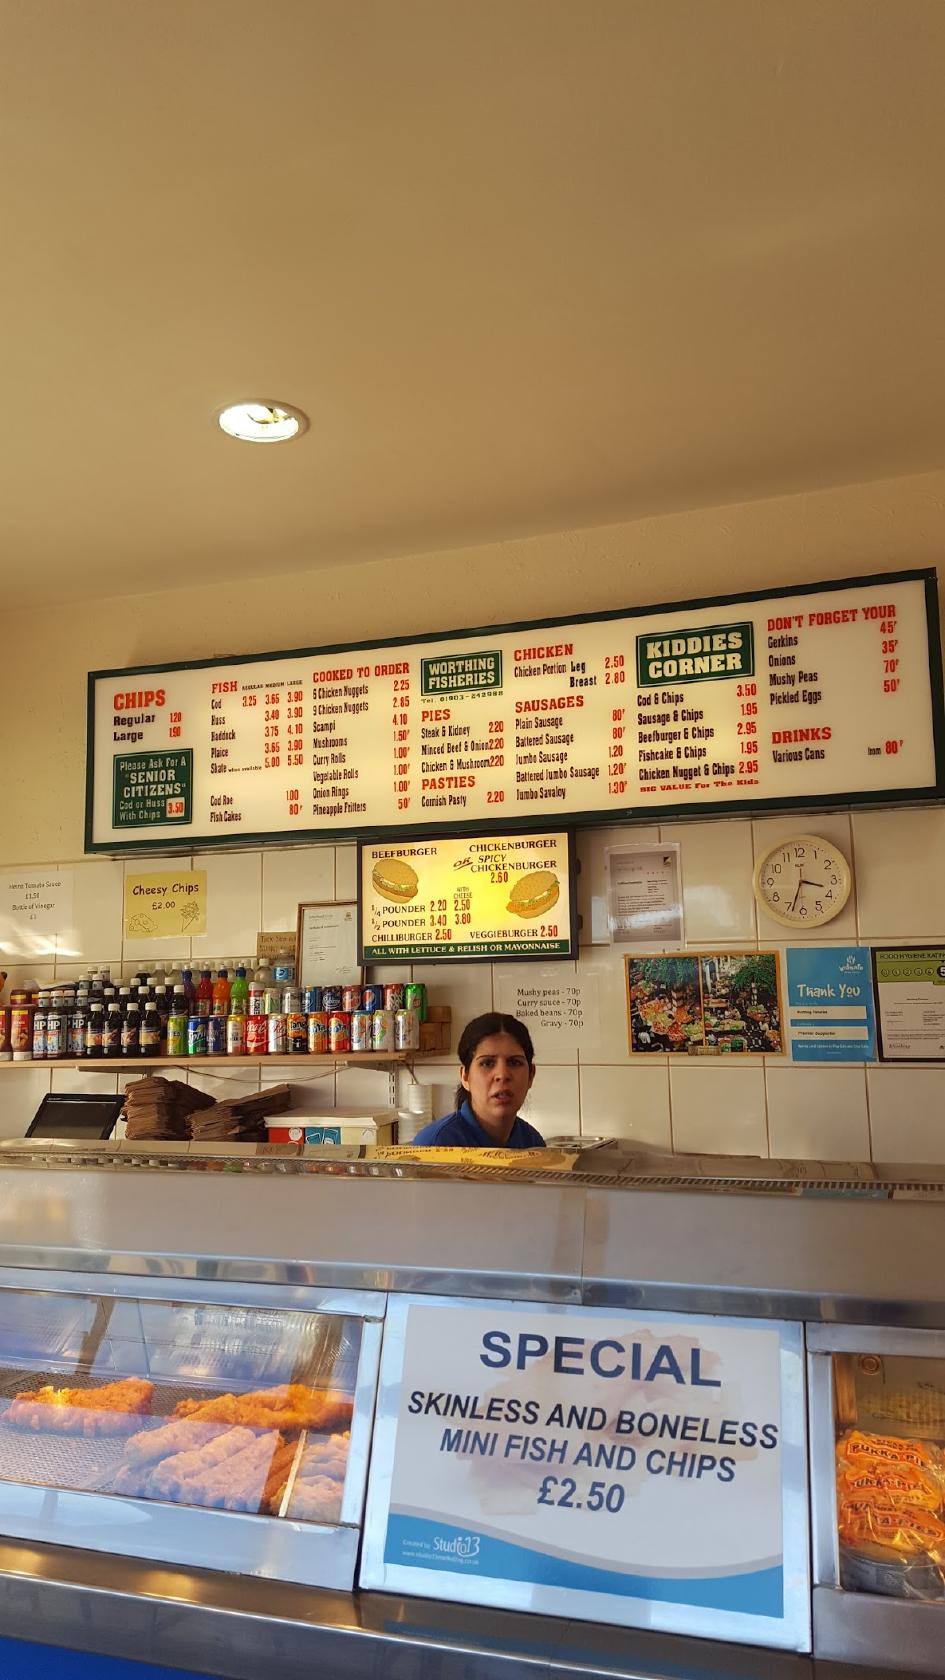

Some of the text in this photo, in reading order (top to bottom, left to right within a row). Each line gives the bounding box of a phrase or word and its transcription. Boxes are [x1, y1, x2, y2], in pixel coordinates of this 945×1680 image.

[768, 604, 896, 632] DON'T FORGET YOUR
[646, 632, 742, 658] KIDDIES
[768, 635, 798, 648] Gerkins
[514, 644, 573, 662] CHICKEN
[428, 657, 495, 676] WORTHING
[514, 655, 624, 678] Chicken Leg 2.50
[648, 653, 742, 679] CORNER
[768, 654, 796, 667] Onions
[313, 662, 410, 683] COOKED TO ORDER
[570, 671, 625, 688] Breast 2.80
[770, 671, 818, 686] Mushy Peas
[428, 671, 495, 689] FISHERIES
[212, 681, 238, 694] FISH
[318, 680, 410, 700] Chicken Nuggets 2.25
[114, 689, 166, 711] CHIPS
[638, 684, 756, 706] Cod Chips 3.50
[770, 690, 822, 706] Pickled Eggs
[318, 701, 368, 716] Chicken Nuggets
[515, 695, 584, 713] SAUSAGES
[114, 714, 156, 727] Regular
[421, 708, 450, 722] PIES
[638, 709, 704, 726] Sausage Chips
[313, 720, 336, 733] Scampi
[516, 716, 563, 730] Plain Sausage
[114, 731, 144, 742] Large
[211, 730, 236, 741] Haddock
[422, 725, 470, 739] Steak Kidney
[638, 722, 756, 744] Beefburger Chips 2.95
[772, 727, 832, 744] DRINKS
[313, 737, 348, 749] Mushrooms
[516, 732, 574, 748] Battered Sausage
[211, 746, 228, 758] Plaice
[422, 741, 462, 756] Minced Beef
[516, 745, 623, 765] Jumbo Sausage 1.20
[638, 746, 706, 762] Fishcake Chips
[772, 746, 882, 763] Various Cans from
[120, 758, 178, 772] Please Ask For
[313, 752, 346, 766] Curry Rolls
[210, 763, 227, 774] Skate
[422, 760, 448, 773] Chicken
[638, 760, 758, 781] Chicken Nugget Chips 2.95
[313, 768, 358, 784] Vegetable Rolls
[516, 766, 600, 782] Battered Jumbo Sausage
[422, 776, 476, 790] PASTIES
[313, 786, 349, 799] Onion Rings
[422, 790, 504, 807] Cornish Pasty 2.20
[516, 788, 538, 800] Jumbo
[120, 810, 160, 820] With Chips
[313, 802, 366, 816] Pineapple Fritters
[224, 811, 242, 822] Cakes
[372, 847, 438, 859] BEEFBURGER
[469, 840, 557, 853] CHICKENBURGER
[794, 848, 805, 858] 12
[470, 860, 557, 872] CHICKENBURGER
[478, 854, 506, 864] SPICY
[772, 864, 782, 874] 10
[491, 871, 508, 884] 2.60
[830, 874, 838, 885] 3
[132, 883, 199, 896] Cheesy Chips
[772, 892, 780, 902] 8
[152, 901, 176, 910] £2.00
[382, 898, 470, 914] POUNDER 2.20 2.50
[382, 912, 471, 928] POUNDER 3.40 3.80
[372, 928, 452, 942] CHILLIBURGER 2.50
[470, 925, 558, 939] VEGGIEBURGER 2.50
[410, 946, 447, 954] LETTUCE
[457, 944, 488, 952] RELISH
[504, 942, 560, 951] MAYONNAISE
[517, 988, 541, 997] Mushy
[566, 988, 580, 996] 70p
[797, 984, 860, 998] Thank You
[517, 999, 538, 1007] Curry
[567, 998, 581, 1007] 70p
[568, 1009, 582, 1018] 70p
[34, 1020, 46, 1030] HP
[48, 1020, 60, 1030] HP
[72, 1019, 84, 1028] HP
[540, 1020, 584, 1028] Gravy 70p
[480, 1330, 722, 1388] SPECIAL
[408, 1390, 778, 1450] SKINLESS AND BONELESS
[440, 1428, 736, 1482] MINI FISH AND CHIPS
[537, 1476, 625, 1514] £2.50
[433, 1536, 480, 1558] Studio13
